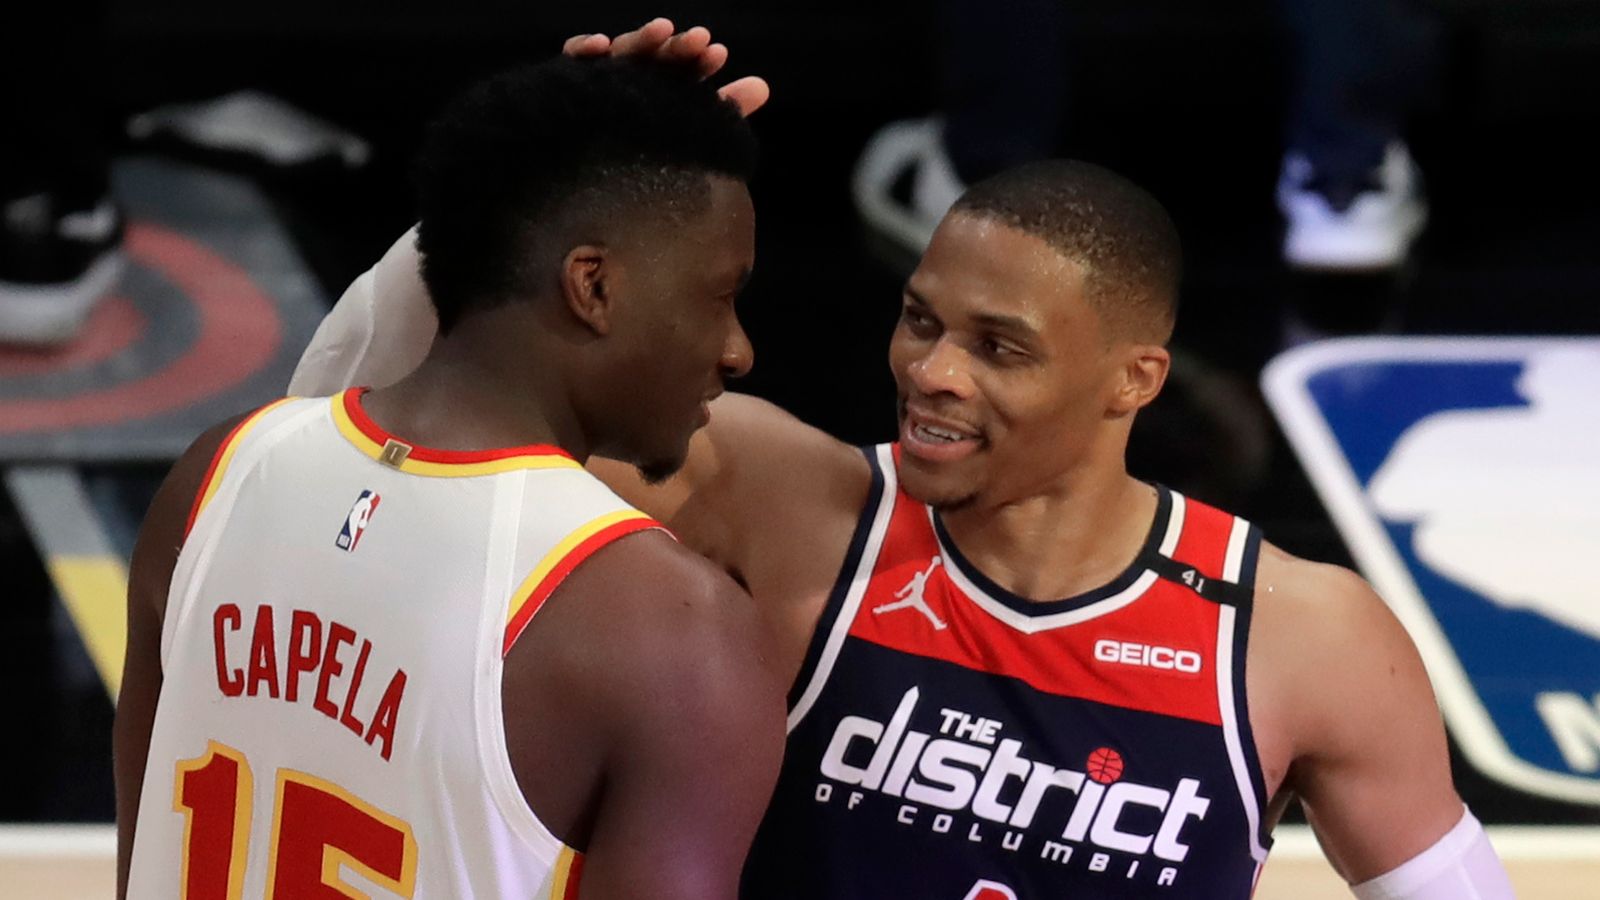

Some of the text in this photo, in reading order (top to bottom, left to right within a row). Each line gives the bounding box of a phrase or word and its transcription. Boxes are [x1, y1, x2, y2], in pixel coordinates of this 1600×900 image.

[1181, 569, 1205, 594] 41
[1094, 639, 1202, 674] GEICO
[213, 603, 408, 762] CAPELA
[940, 708, 1002, 745] THE
[819, 685, 1211, 863] district
[815, 783, 864, 810] OF
